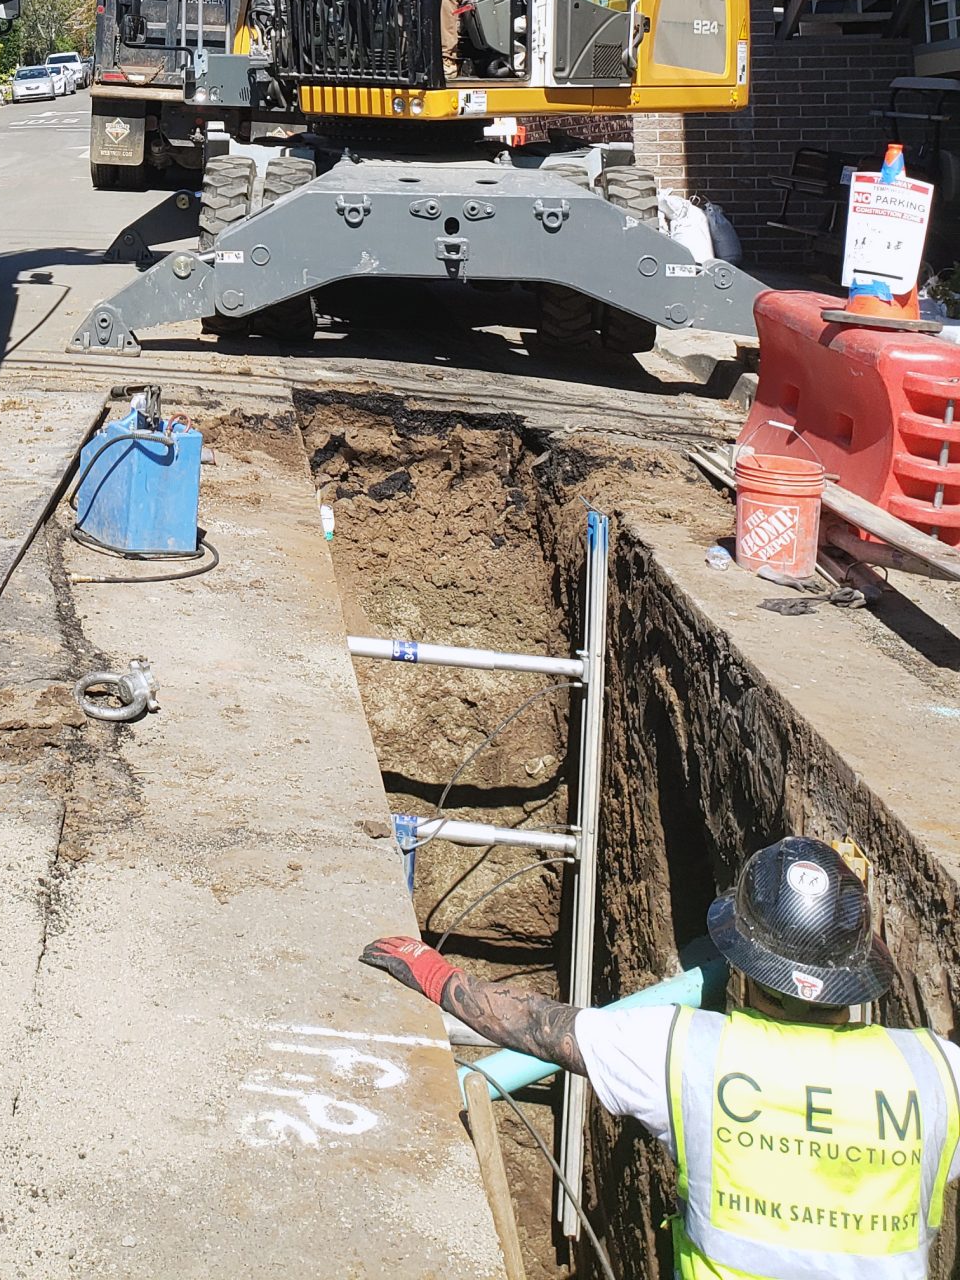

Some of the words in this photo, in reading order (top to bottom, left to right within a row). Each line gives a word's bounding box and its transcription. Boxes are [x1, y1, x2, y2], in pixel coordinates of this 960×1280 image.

[693, 19, 718, 35] 924
[854, 192, 871, 204] NO
[875, 195, 926, 213] PARKING
[741, 507, 797, 556] HOME
[745, 508, 768, 530] THE
[757, 528, 796, 561] DEPOT
[716, 1126, 921, 1166] CONSTRUCTION
[716, 1189, 782, 1219] THINK
[790, 1205, 864, 1231] SAFETY
[871, 1211, 918, 1232] FIRST
